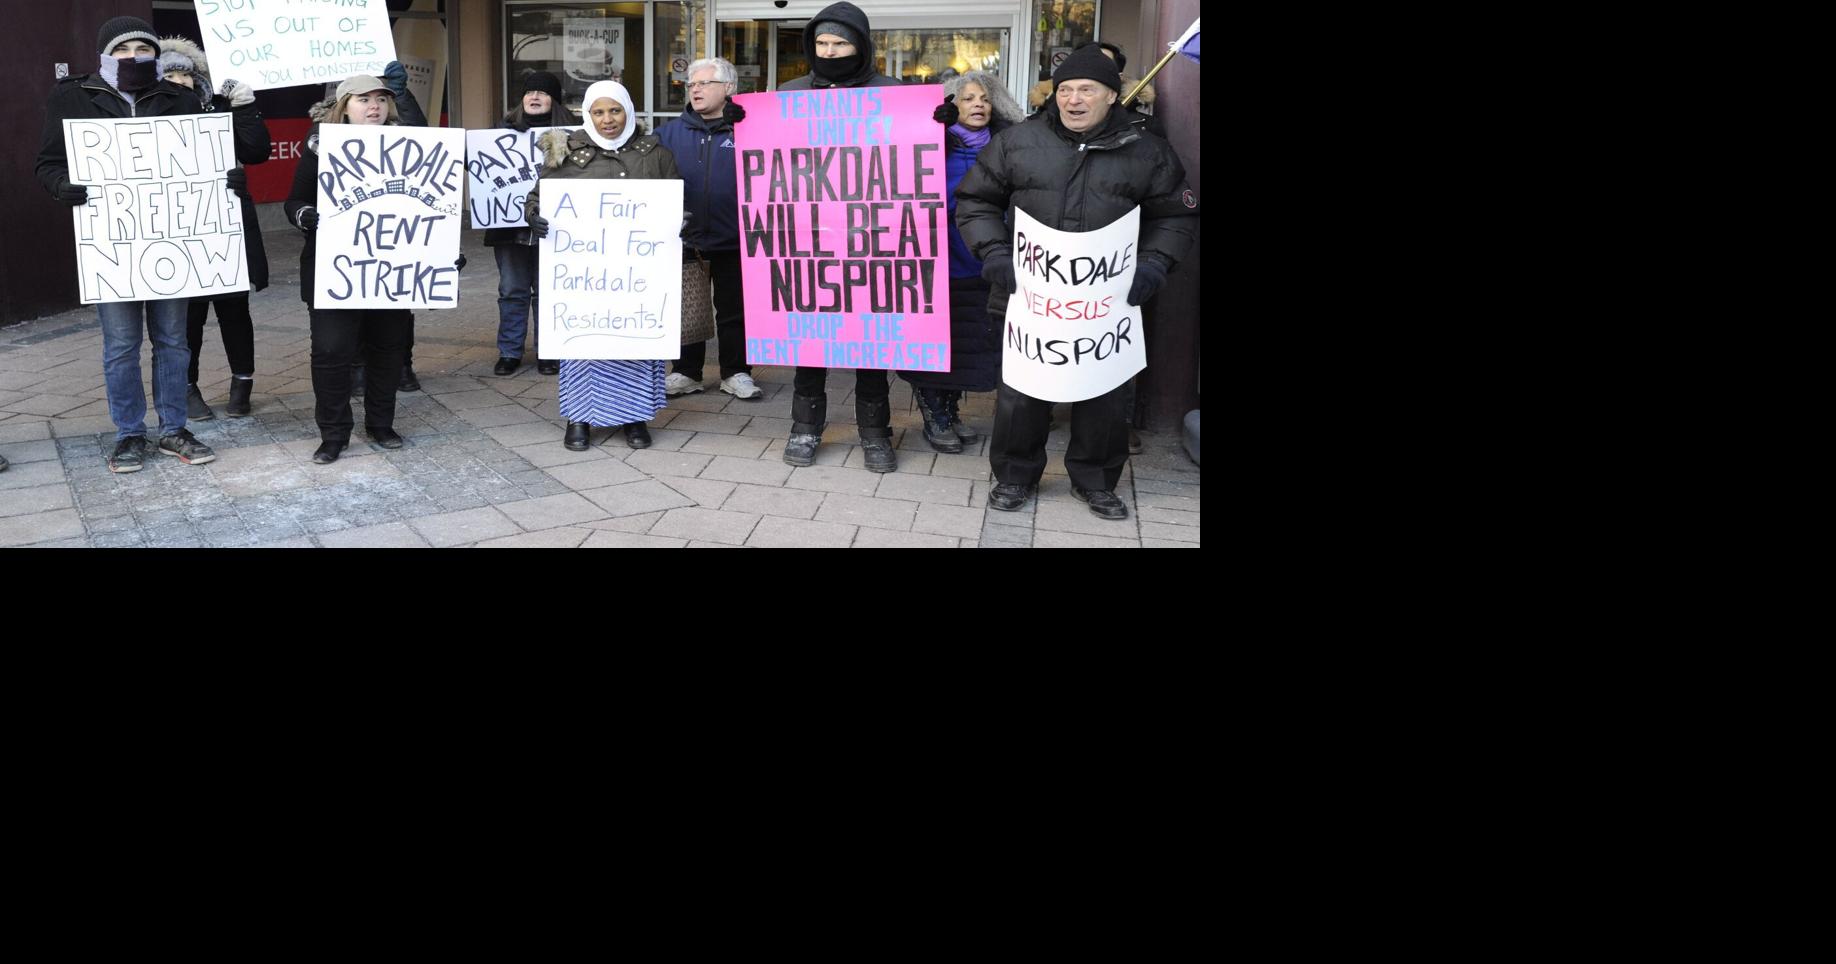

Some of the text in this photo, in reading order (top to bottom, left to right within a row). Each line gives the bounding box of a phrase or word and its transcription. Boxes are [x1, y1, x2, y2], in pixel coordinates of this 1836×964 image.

[211, 16, 368, 43] US OUT OF
[229, 40, 377, 66] OUR HOMES
[258, 68, 293, 85] YOU
[302, 60, 386, 80] MONSTERS
[776, 87, 883, 119] TENANTS
[70, 115, 230, 181] RENT
[807, 115, 894, 146] UNITE!
[318, 134, 463, 207] PARKDALE
[742, 143, 940, 203] PARKDALE
[79, 178, 242, 240] FREEZE
[553, 192, 647, 219] A Fair
[353, 211, 446, 257] RENT
[553, 228, 665, 257] Deal For
[741, 201, 945, 258] WILL BEAT
[79, 233, 243, 301] NOW
[552, 263, 648, 293] Parkdale
[1017, 231, 1134, 286] PARKDALE
[327, 254, 457, 304] STRIKE
[770, 258, 935, 314] NUSPOR!
[553, 292, 668, 332] Residents!
[1022, 287, 1114, 321] VERSUS
[787, 312, 906, 342] DROP THE
[1007, 316, 1132, 366] NUSPOR
[747, 338, 948, 371] RENT INCREASE!
